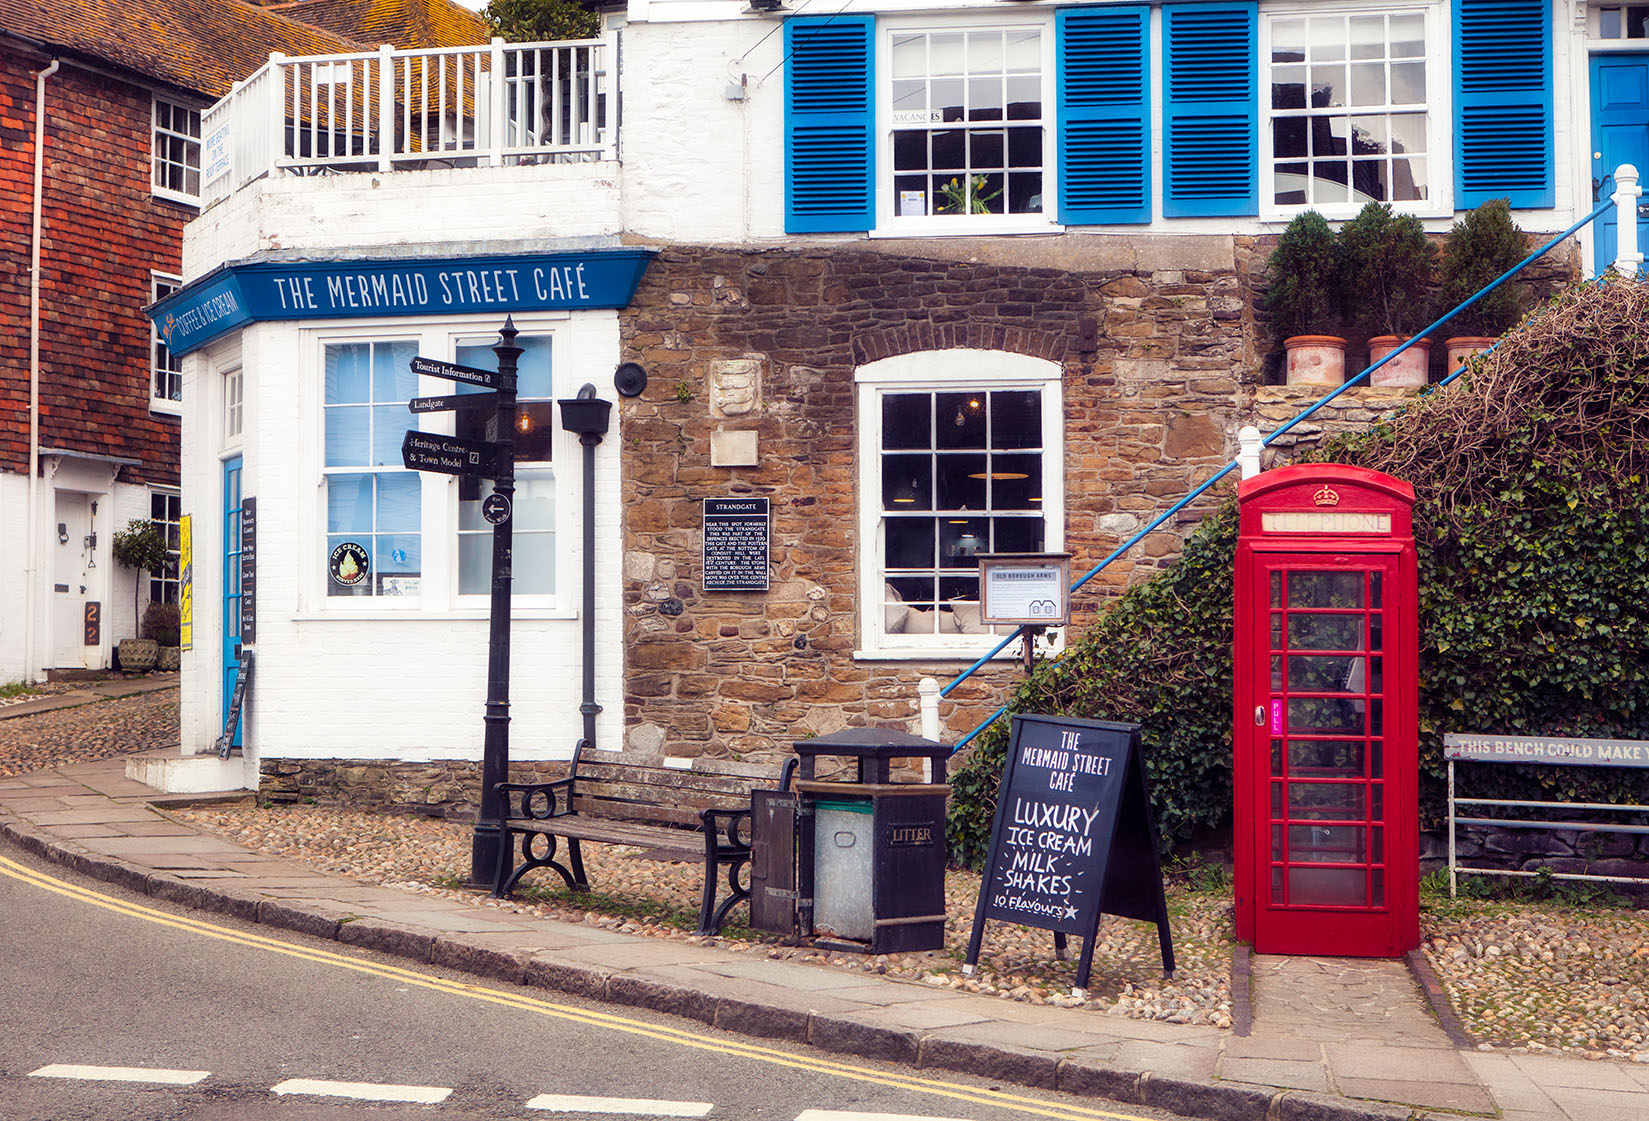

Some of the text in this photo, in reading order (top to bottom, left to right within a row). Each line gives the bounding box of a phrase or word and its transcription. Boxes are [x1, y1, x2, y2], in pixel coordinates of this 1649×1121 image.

[273, 262, 590, 309] THE MERMAID STREET CAFÉ
[176, 290, 240, 337] COFFEE & ICE CREAM
[415, 360, 483, 382] Tourist Information
[414, 399, 444, 410] Landgate
[409, 438, 466, 453] Heritage Centre
[409, 453, 462, 468] & Town Model
[332, 544, 367, 560] ICE CREAM
[1061, 731, 1081, 751] THE
[1457, 740, 1491, 754] THIS
[1495, 741, 1544, 756] BENCH
[1547, 743, 1593, 759] COULD
[1597, 745, 1641, 760] MAKE
[1021, 747, 1113, 776] MERMAID STREET
[1049, 771, 1076, 793] CAFÉ
[1014, 797, 1100, 836] LUXURY
[893, 828, 931, 841] LITTER
[1006, 826, 1092, 857] ICE CREAM
[1012, 851, 1059, 874] MILK
[1003, 870, 1073, 895] SHAKES
[995, 895, 1063, 916] 10 Flavours
